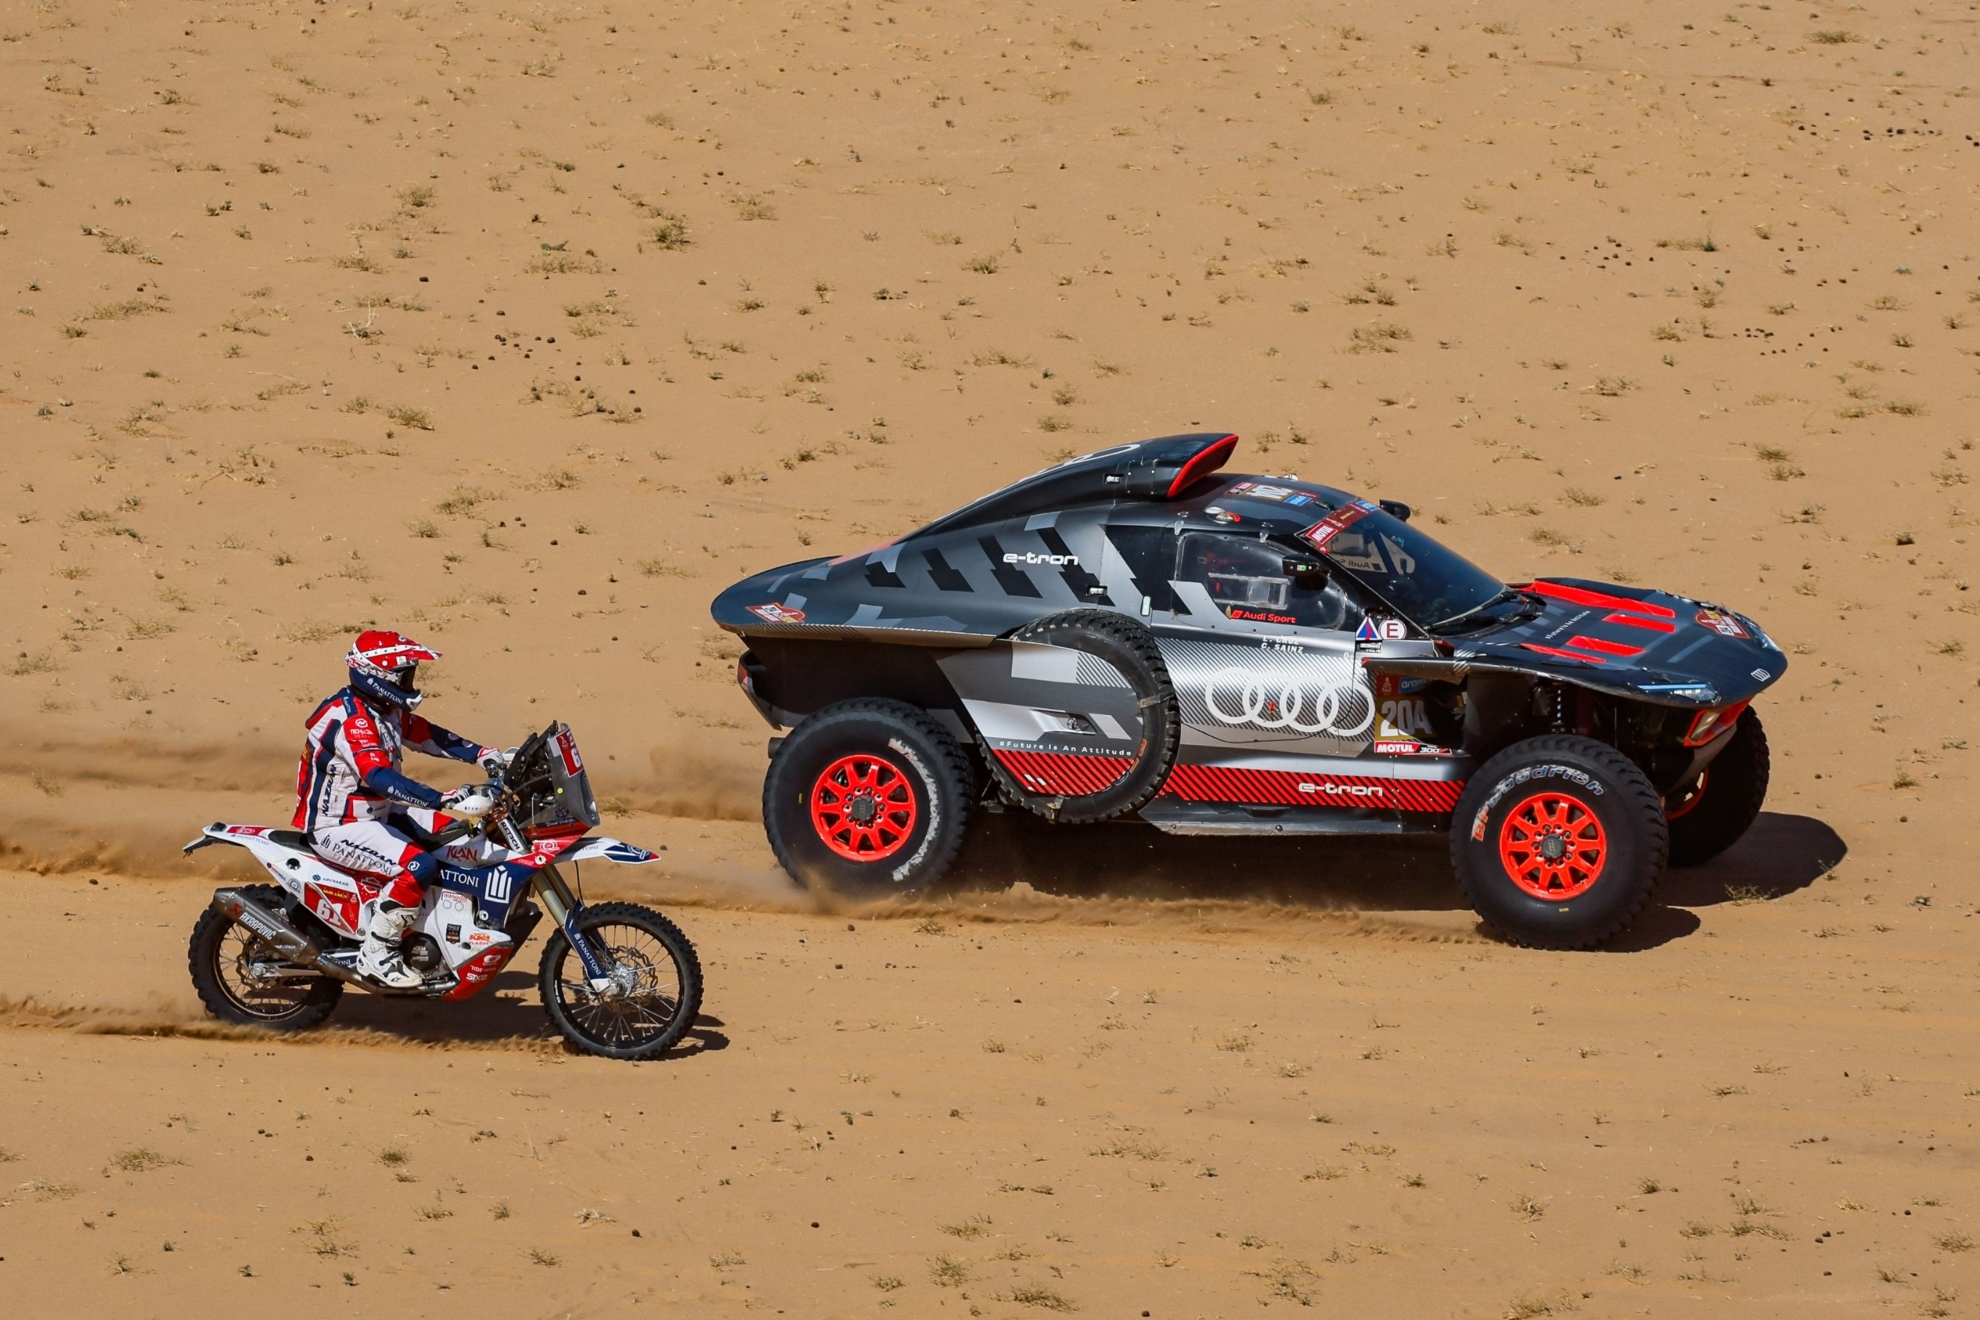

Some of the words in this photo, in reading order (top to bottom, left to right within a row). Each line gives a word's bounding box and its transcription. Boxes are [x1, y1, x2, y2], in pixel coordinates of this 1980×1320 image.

[1003, 552, 1079, 565] e-tron
[1243, 611, 1265, 620] Audi
[1267, 614, 1296, 623] Sport
[1386, 623, 1399, 638] E
[1276, 635, 1300, 645] CRUZ
[1274, 644, 1304, 654] SAINZ
[1401, 680, 1428, 689] aram
[1380, 700, 1433, 737] 204
[999, 741, 1044, 750] #Future
[1081, 746, 1132, 756] Attitude
[1377, 744, 1415, 753] MOTUL
[571, 748, 581, 768] 6
[1298, 783, 1383, 797] e-tron
[332, 843, 393, 875] PANATTONI
[440, 869, 479, 887] ATTONI
[317, 899, 343, 926] 61
[577, 939, 602, 976] PANATTONI
